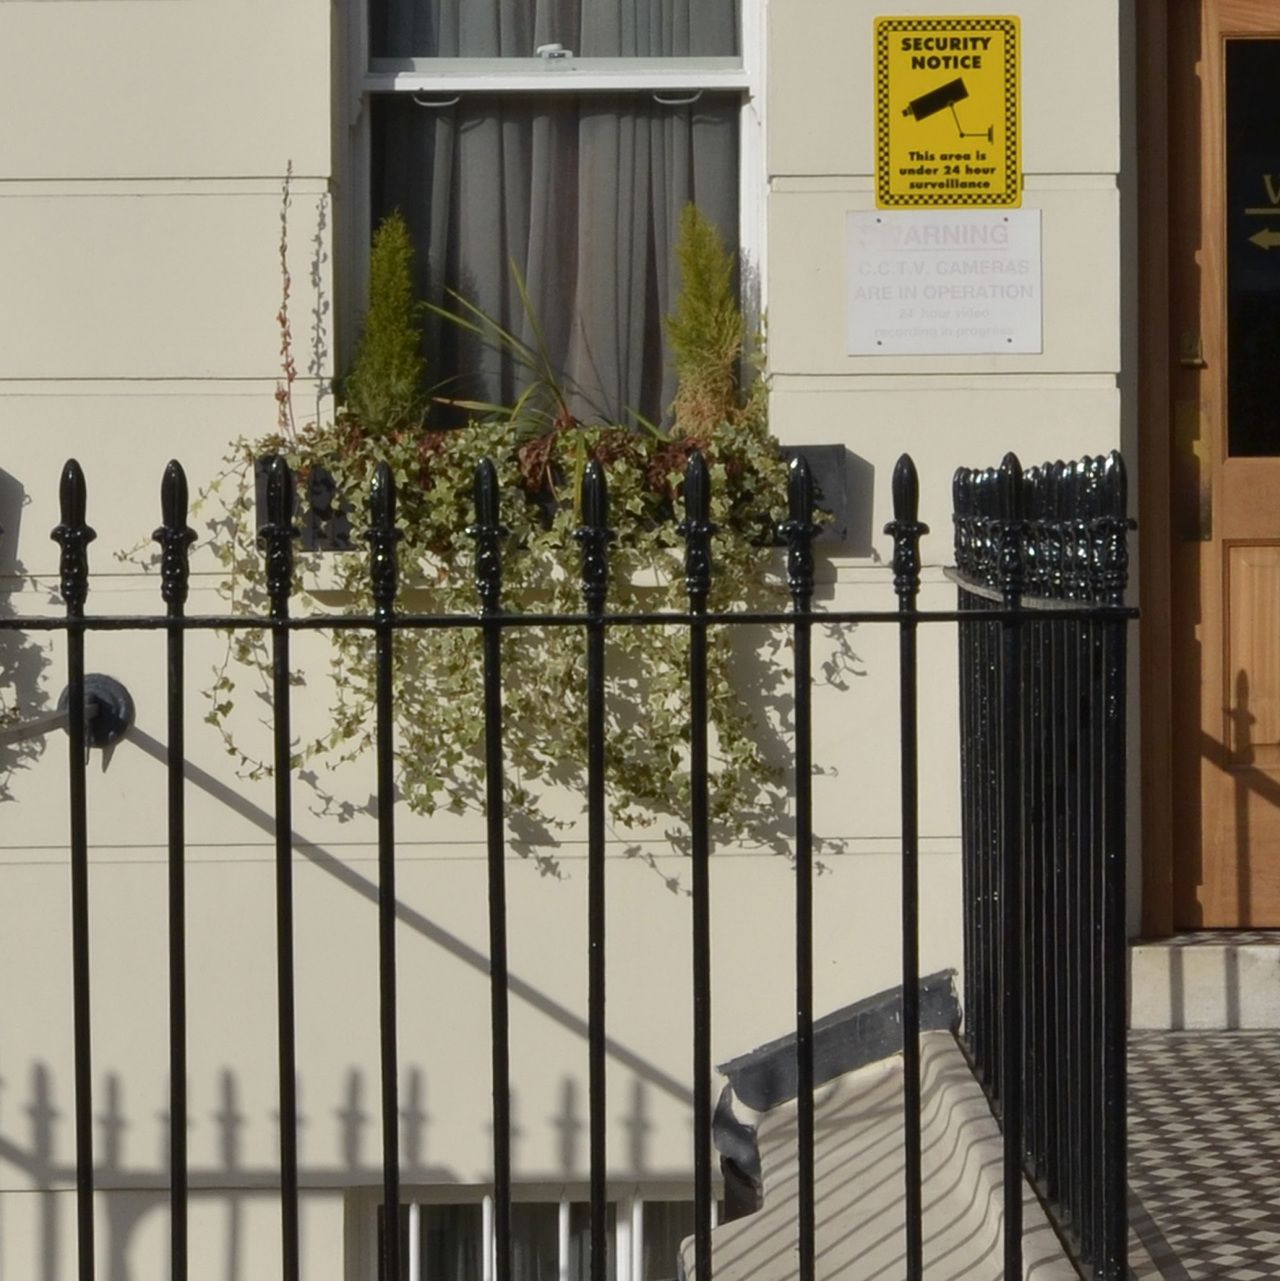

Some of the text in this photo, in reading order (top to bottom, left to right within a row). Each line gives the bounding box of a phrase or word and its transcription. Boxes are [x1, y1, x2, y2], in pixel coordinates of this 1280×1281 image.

[901, 36, 992, 51] SECURITY
[911, 55, 982, 70] NOTICE
[908, 151, 987, 161] This area is
[899, 165, 996, 175] under 24 hour
[909, 178, 991, 189] surveillance
[936, 260, 1031, 275] CAMERAS
[854, 284, 1034, 300] ARE IN OPERATION
